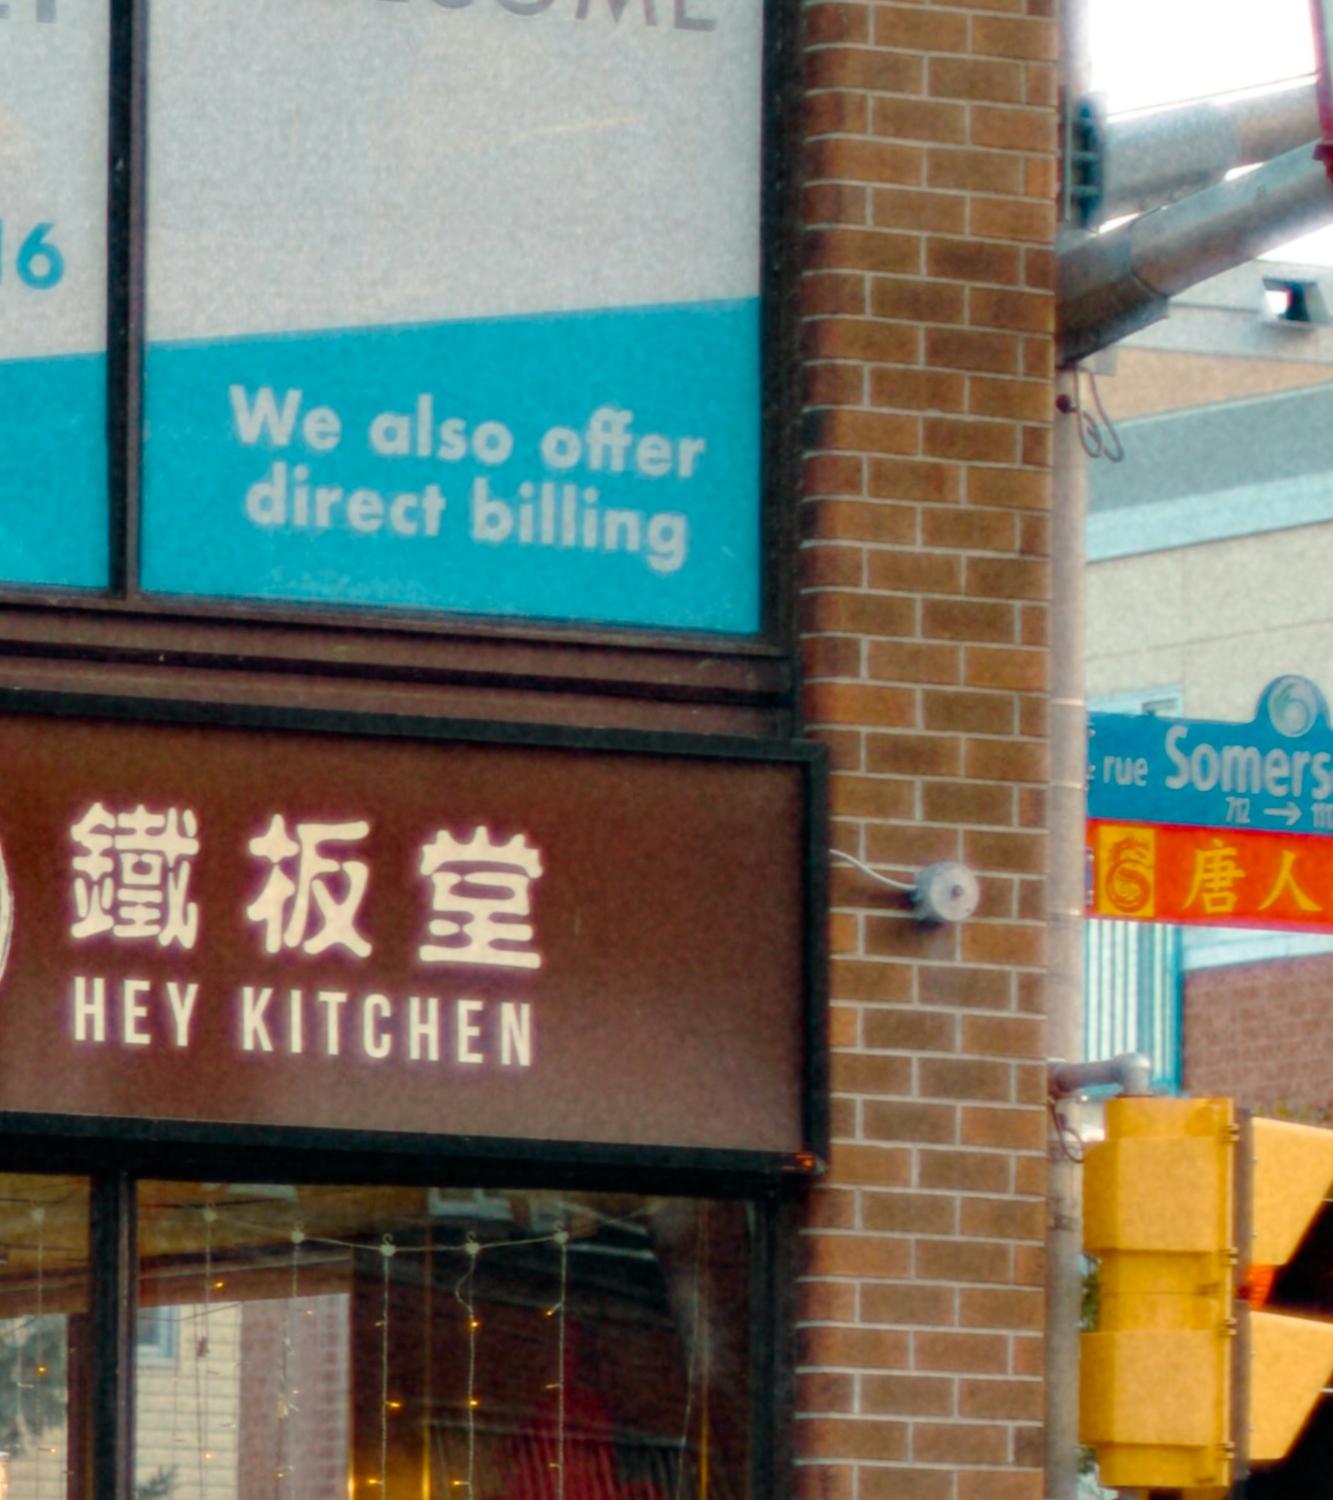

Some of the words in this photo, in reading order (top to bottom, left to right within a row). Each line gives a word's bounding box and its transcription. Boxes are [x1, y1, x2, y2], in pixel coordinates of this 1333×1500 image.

[230, 383, 343, 452] We
[369, 392, 515, 467] also
[539, 405, 707, 480] offer
[244, 461, 445, 540] direct
[471, 482, 690, 574] billing
[1102, 754, 1150, 787] rue
[68, 801, 544, 972] 鐵板堂
[72, 977, 198, 1049] HEY
[240, 987, 534, 1068] KITCHEN
